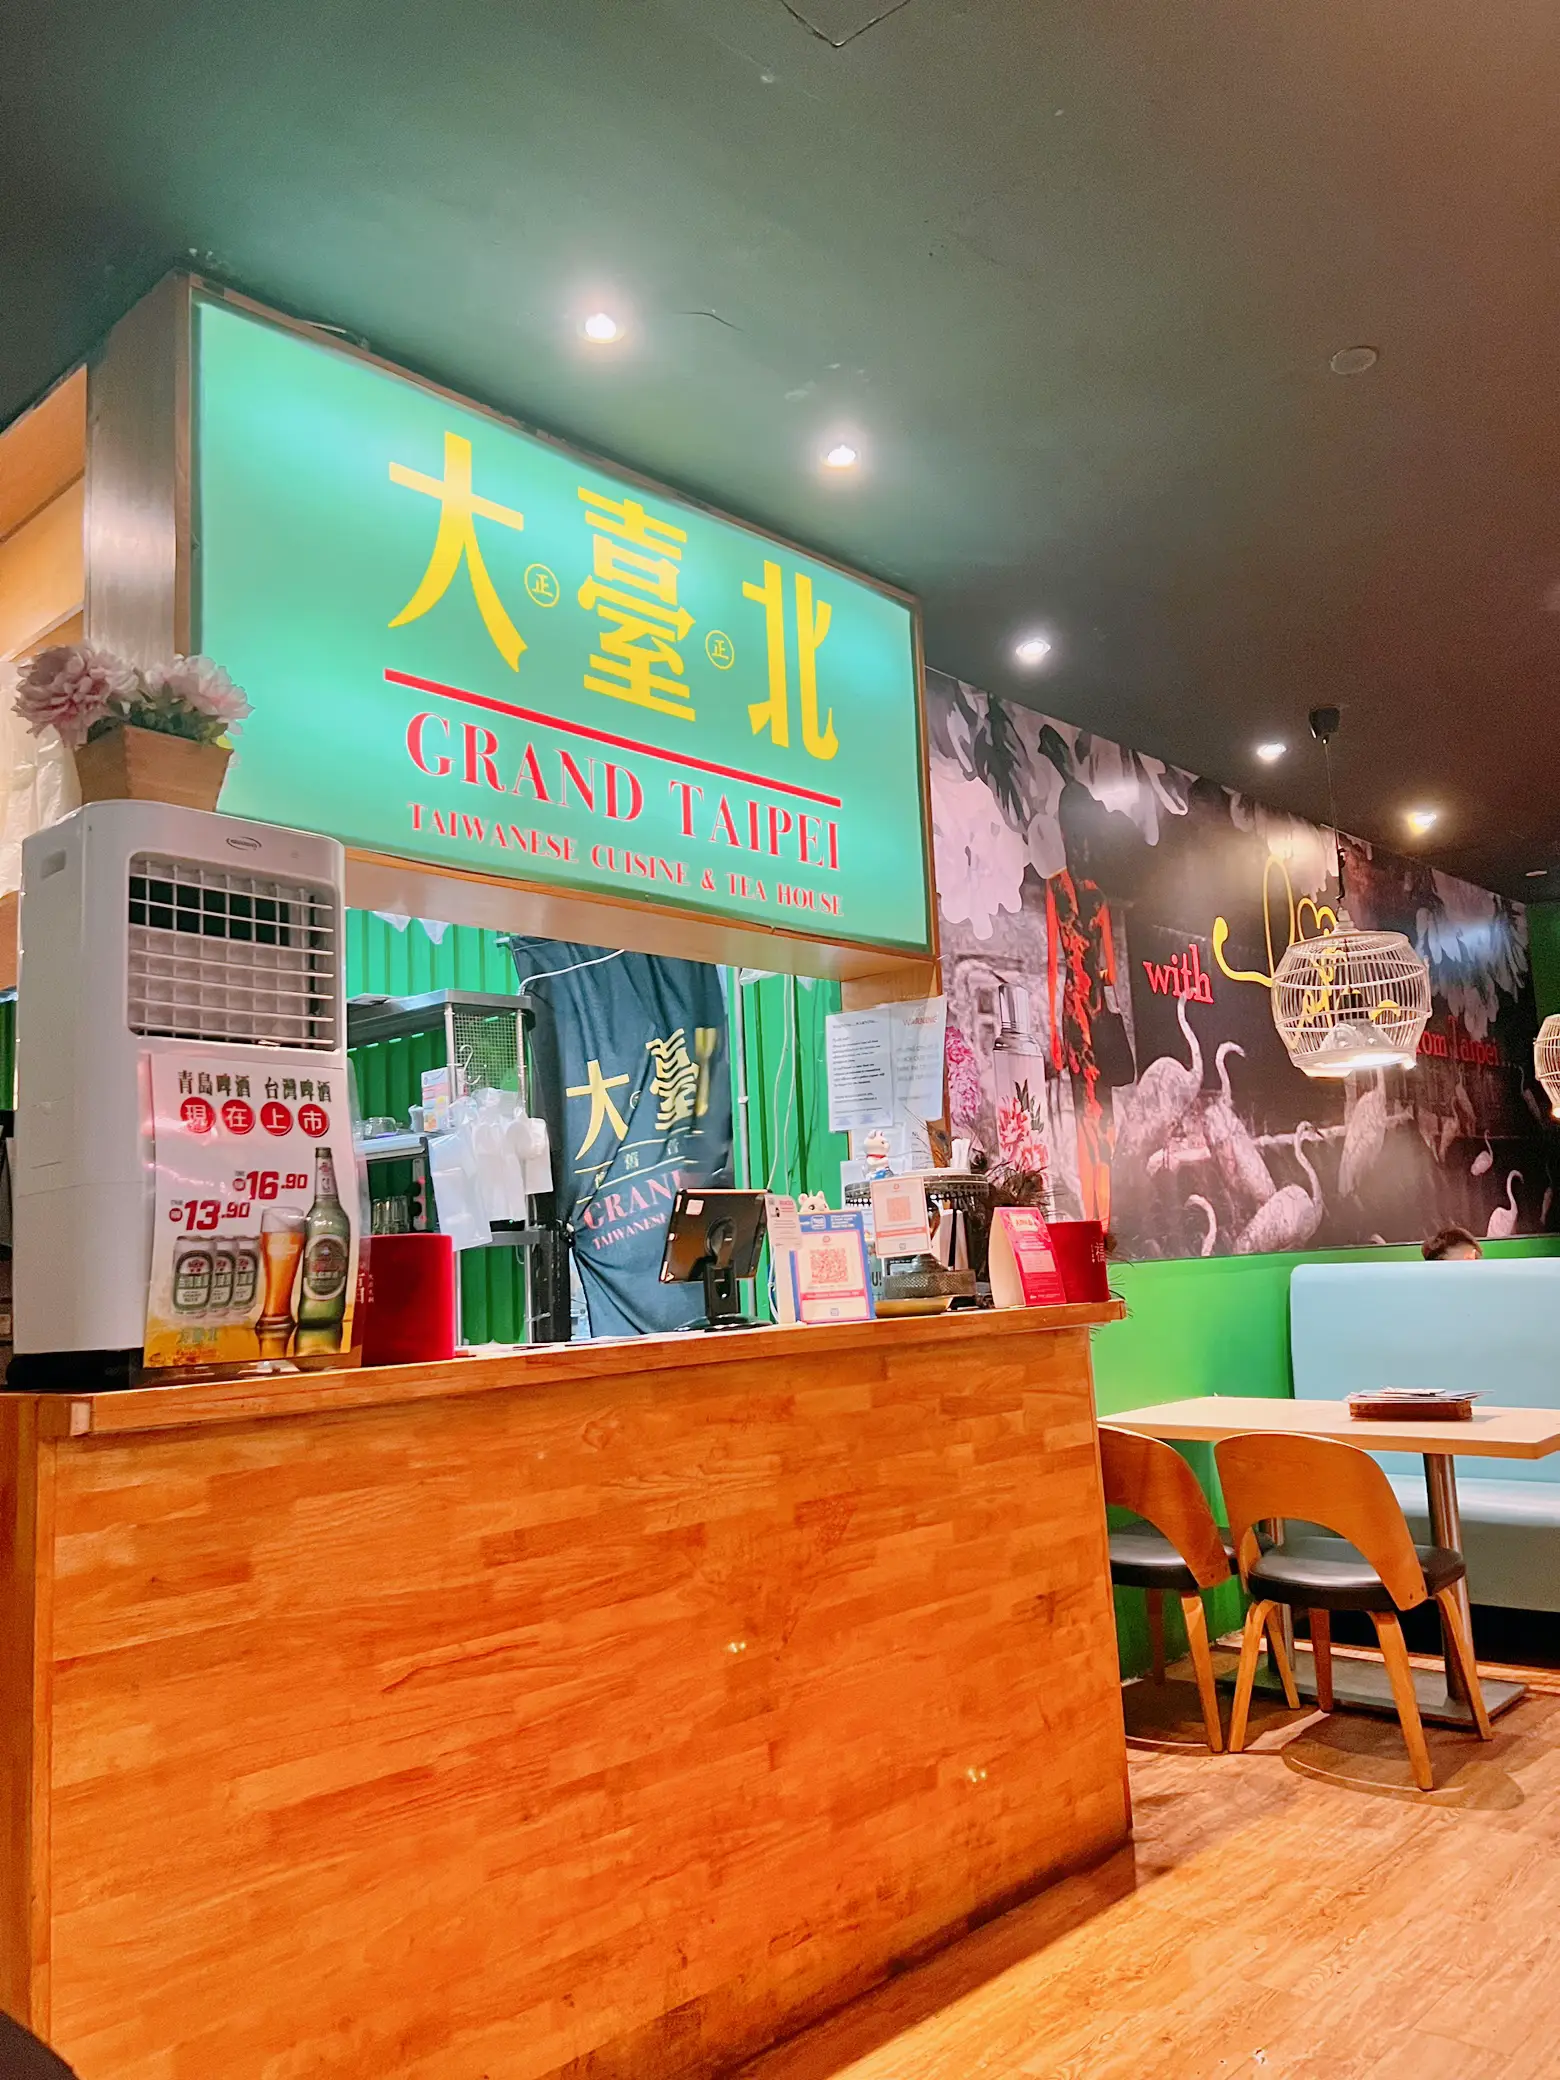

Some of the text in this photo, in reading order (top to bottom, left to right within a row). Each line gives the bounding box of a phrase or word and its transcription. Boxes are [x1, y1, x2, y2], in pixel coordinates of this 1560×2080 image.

[406, 711, 841, 872] GRAND TAIPEI
[408, 801, 844, 917] TAIWANESE CUISINE & TEA HOUSE
[1143, 944, 1214, 1005] with
[1416, 1031, 1448, 1057] om
[178, 1070, 251, 1098] 青島啤酒
[185, 1104, 322, 1132] 現在上市
[246, 1170, 308, 1200] 16.90
[184, 1200, 251, 1231] 13.90
